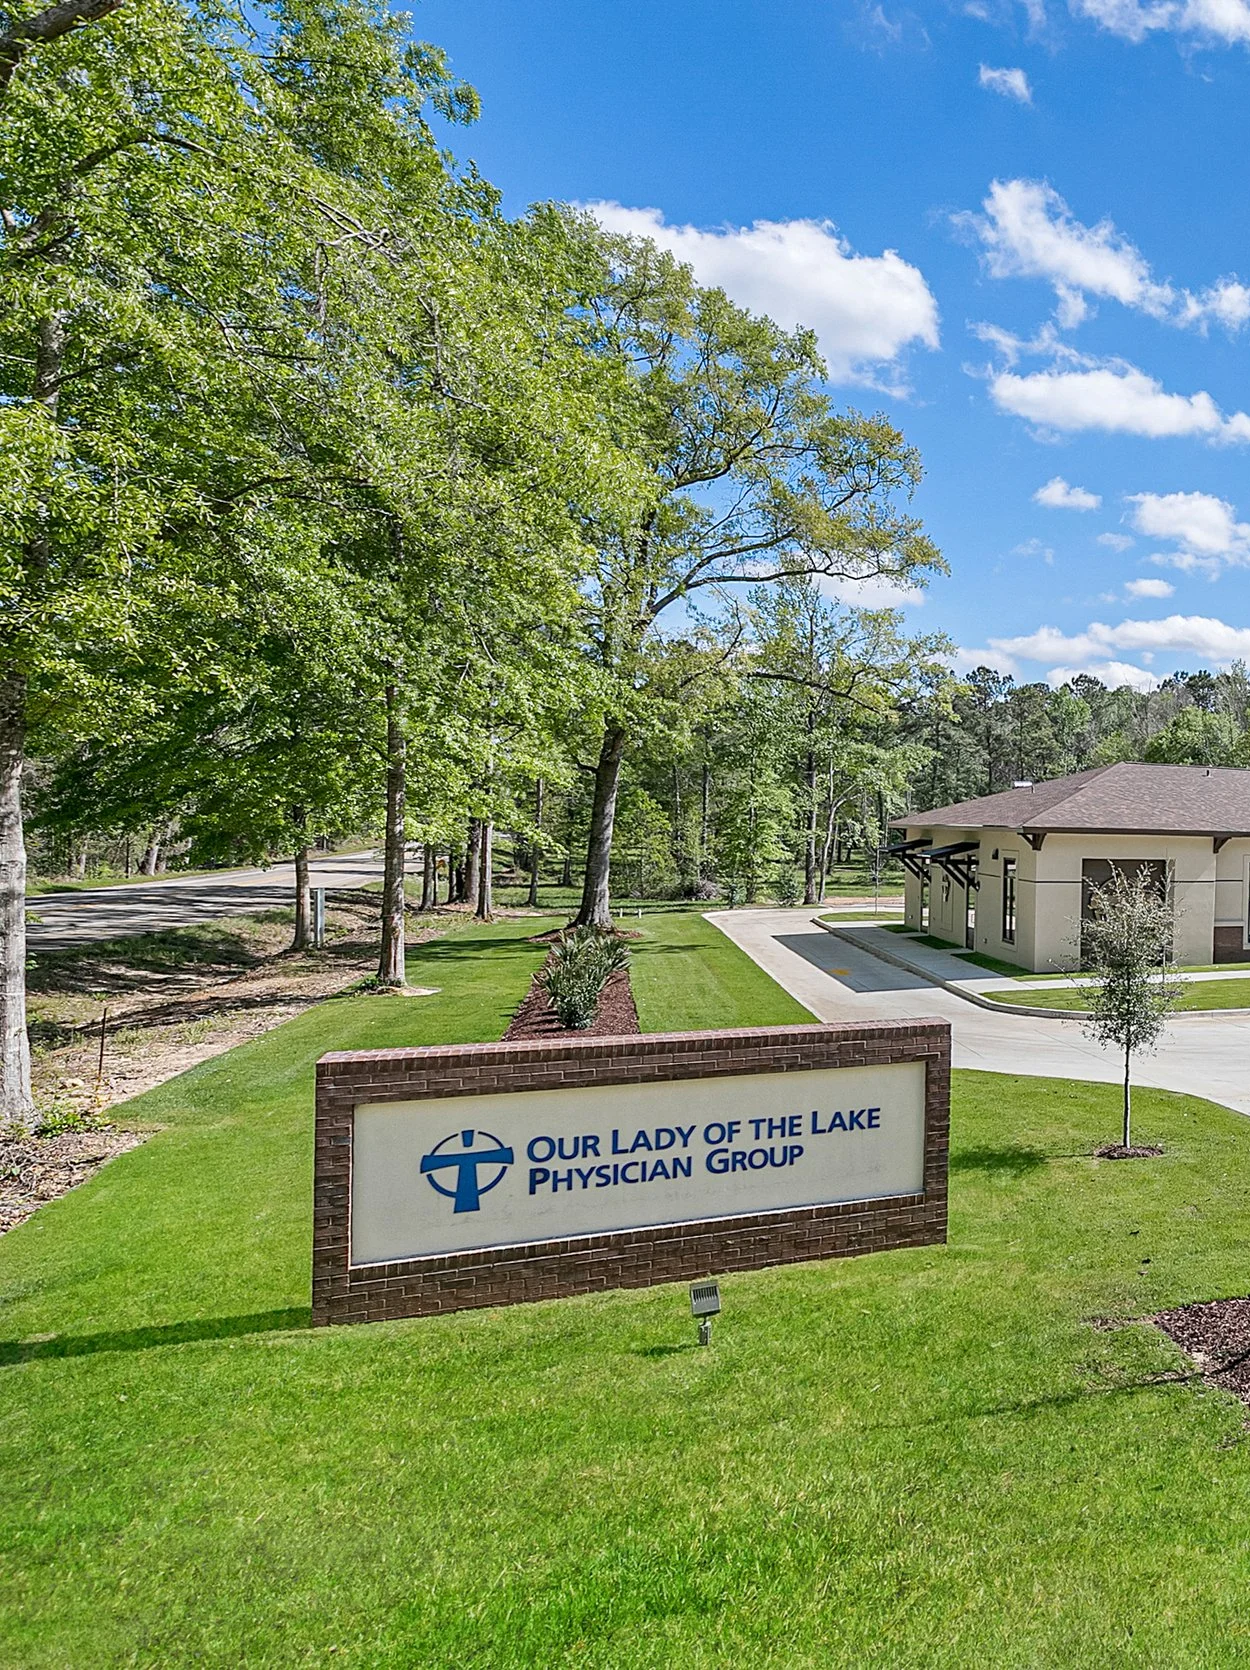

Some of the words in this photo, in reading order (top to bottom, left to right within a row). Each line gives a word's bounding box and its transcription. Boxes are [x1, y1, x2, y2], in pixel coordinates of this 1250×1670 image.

[526, 1134, 601, 1164] OUR
[611, 1125, 696, 1155] LADY
[703, 1120, 739, 1145] OF
[749, 1114, 802, 1139] THE
[810, 1107, 881, 1135] LAKE
[528, 1156, 693, 1195] PHYSICIAN
[705, 1144, 805, 1174] GROUP
